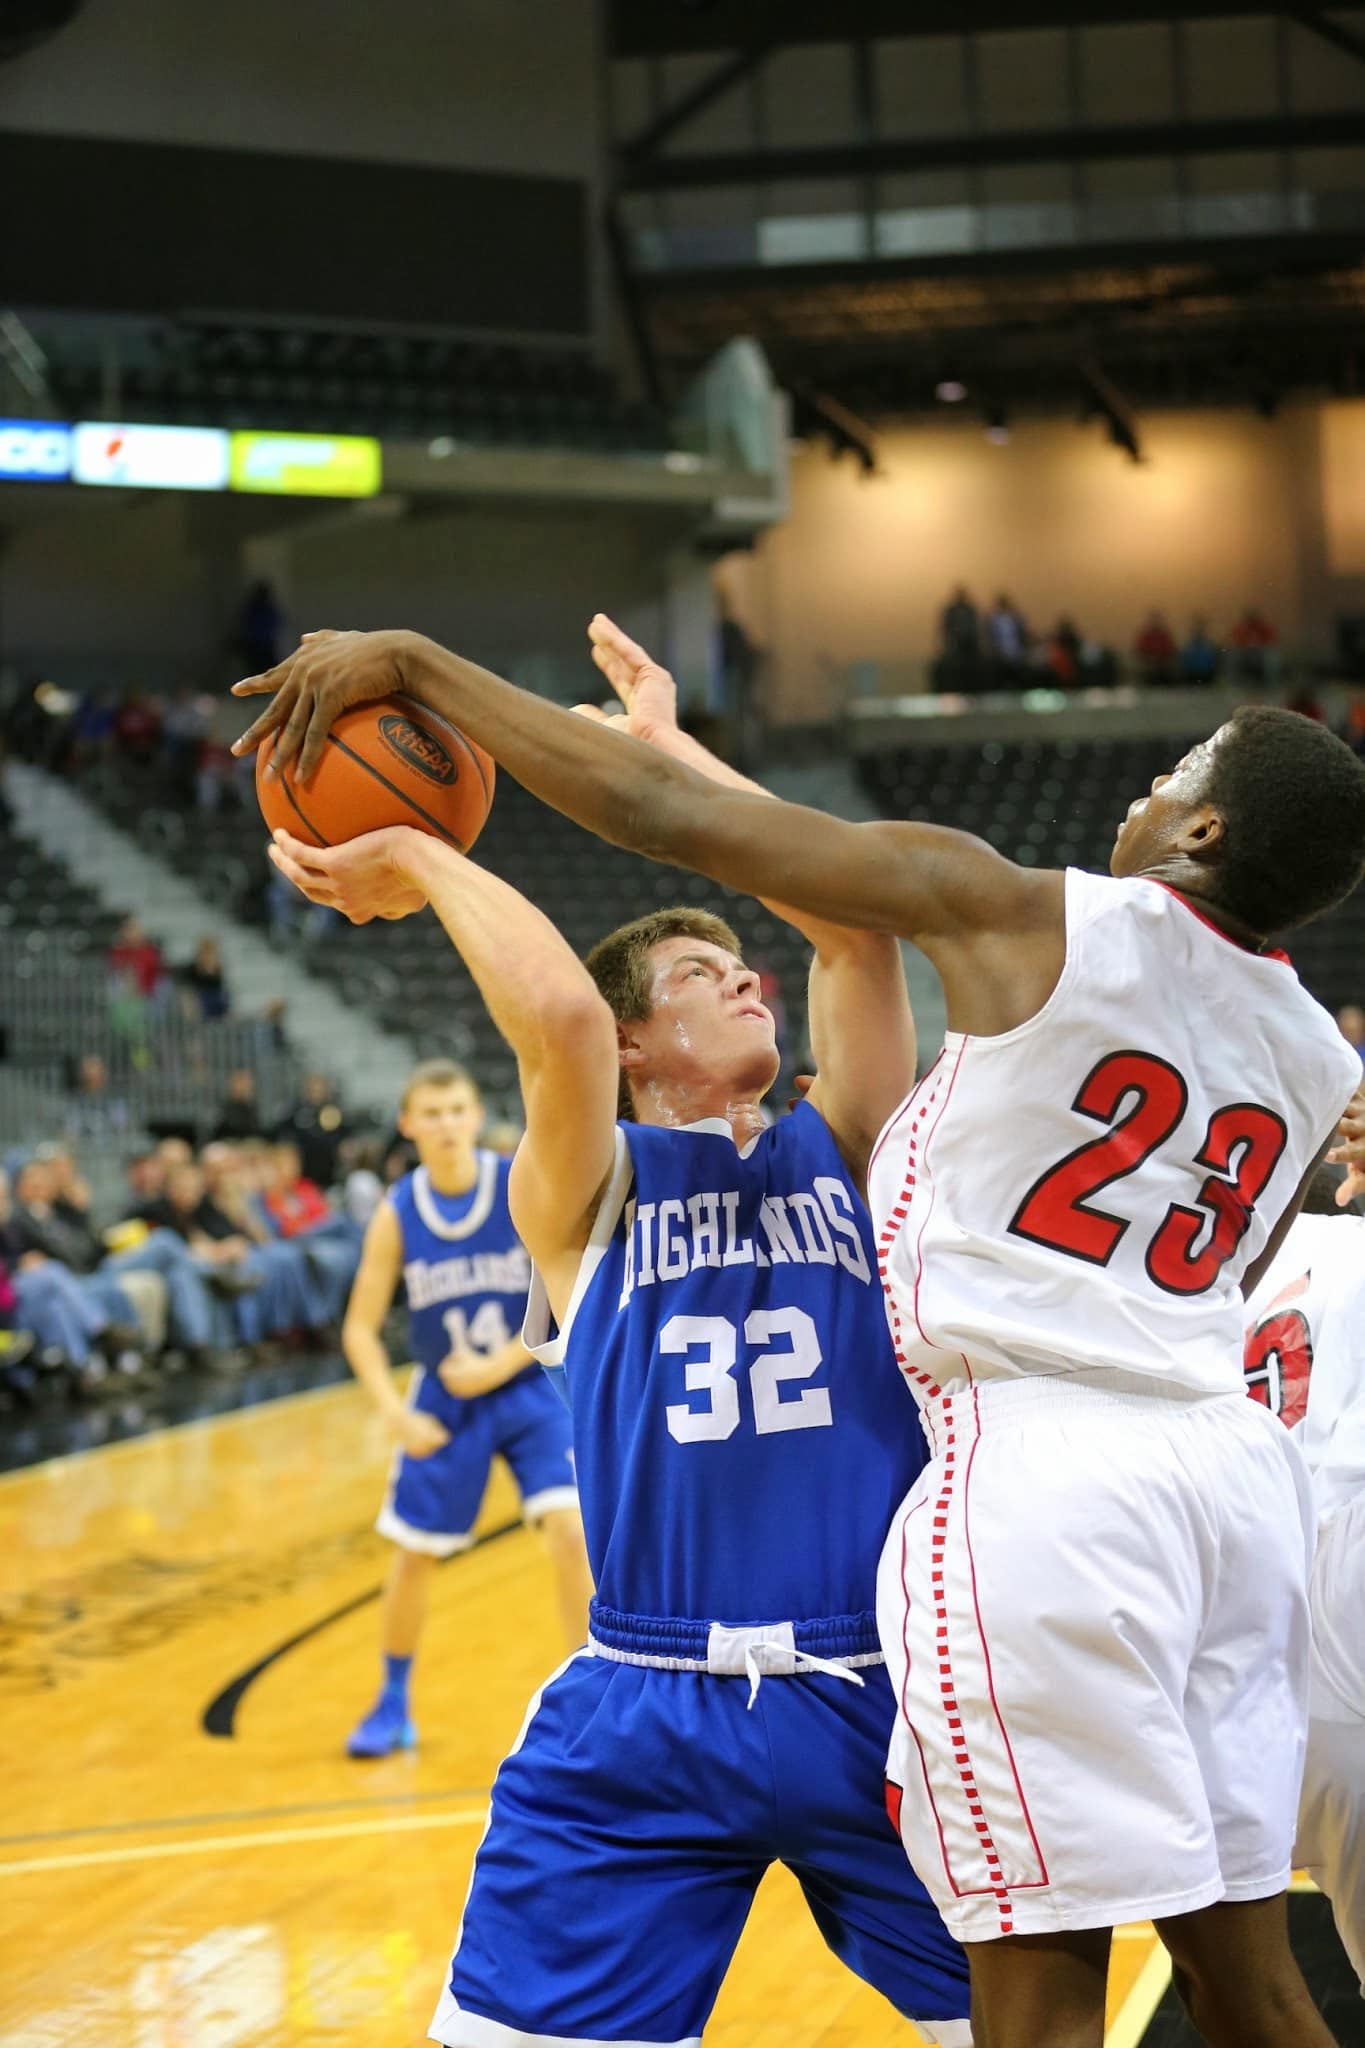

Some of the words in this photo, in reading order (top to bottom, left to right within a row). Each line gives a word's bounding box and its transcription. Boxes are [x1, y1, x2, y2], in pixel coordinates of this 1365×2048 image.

[1007, 1049, 1288, 1297] 23
[618, 1176, 872, 1312] HIGHLNDS
[443, 1300, 511, 1357] 14
[659, 1306, 833, 1444] 32
